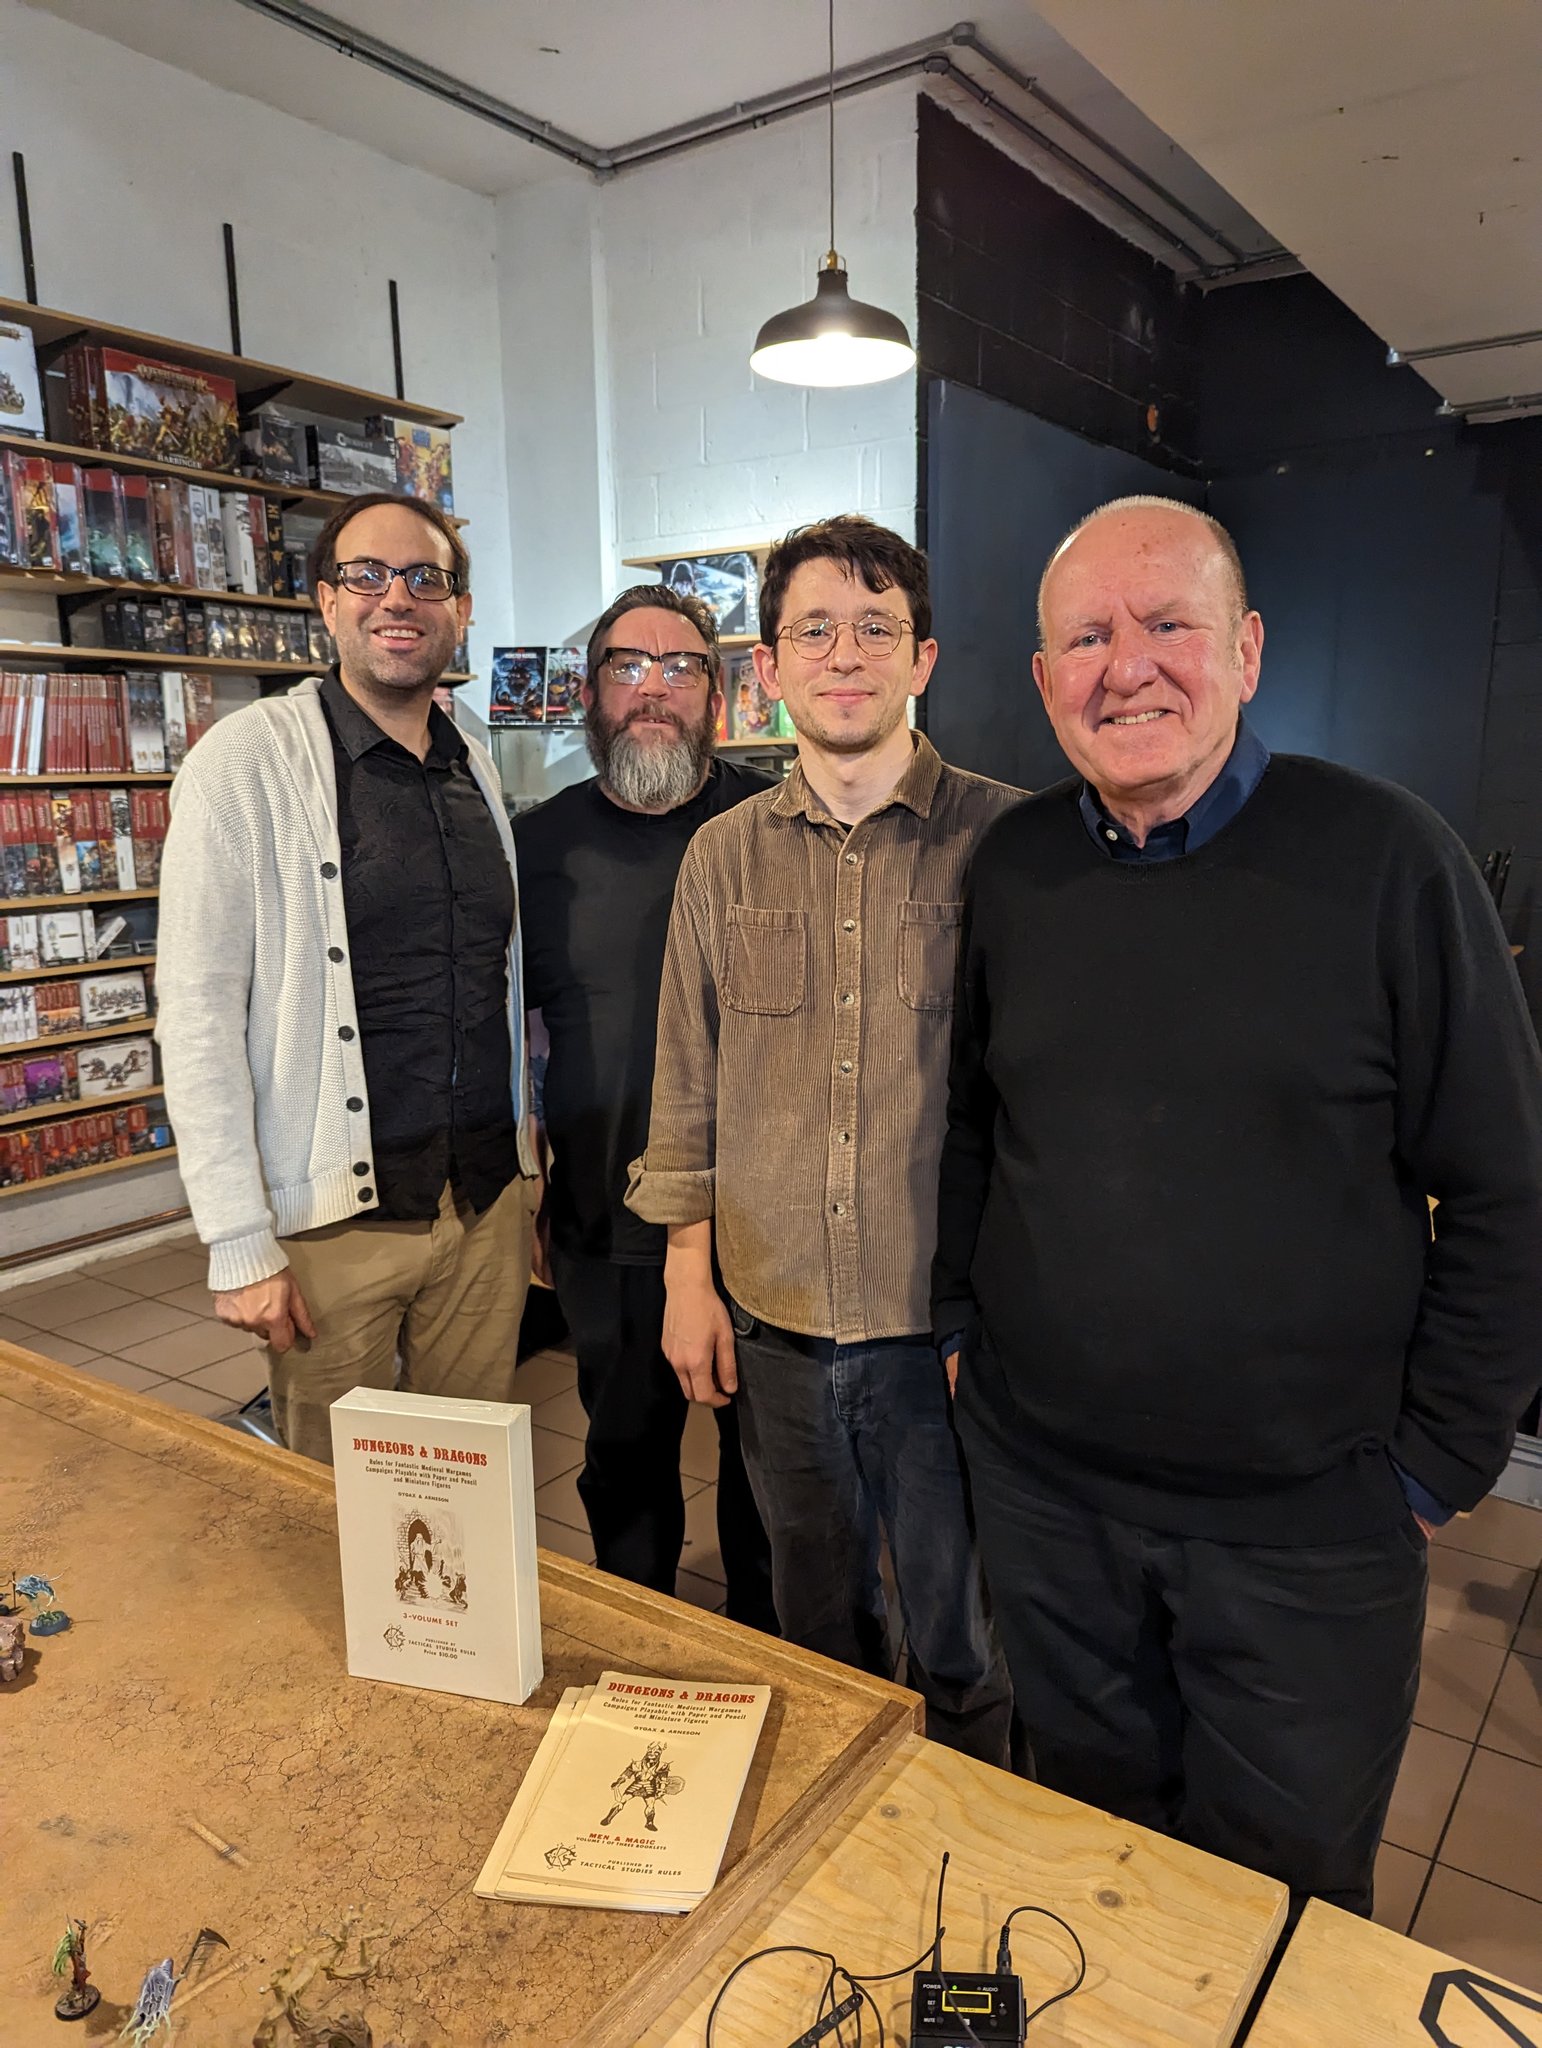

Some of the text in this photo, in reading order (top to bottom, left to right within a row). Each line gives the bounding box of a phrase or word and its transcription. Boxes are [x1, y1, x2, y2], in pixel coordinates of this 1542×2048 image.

[353, 1438, 488, 1466] DUNGEONS & DRAGONS
[370, 1458, 384, 1466] Rules
[395, 1461, 419, 1470] Fantastic
[422, 1464, 444, 1473] Medieval
[446, 1468, 472, 1478] Wargames
[366, 1466, 393, 1476] Campaigns
[395, 1469, 417, 1478] Playable
[432, 1474, 448, 1482] Paper
[461, 1478, 478, 1486] Pencil
[405, 1477, 430, 1486] Miniature
[432, 1481, 451, 1489] Figures
[402, 1612, 442, 1625] 3-VOLUME
[408, 1640, 432, 1648] TACTICAL
[439, 1652, 458, 1660] $10.00
[607, 1682, 755, 1704] DUNGEONS & DRAGONS
[603, 1702, 637, 1712] Campaigns
[640, 1706, 668, 1715] Playable
[611, 1696, 628, 1704] Rules
[632, 1698, 640, 1706] for
[644, 1700, 674, 1709] Fantastic
[677, 1704, 706, 1712] Medieval
[649, 1714, 682, 1722] Miniature
[683, 1717, 709, 1725] Figures
[589, 1832, 610, 1840] MEN
[626, 1837, 656, 1845] MAGIC
[580, 1861, 615, 1871] TACTICAL
[621, 1866, 653, 1874] STUDIES
